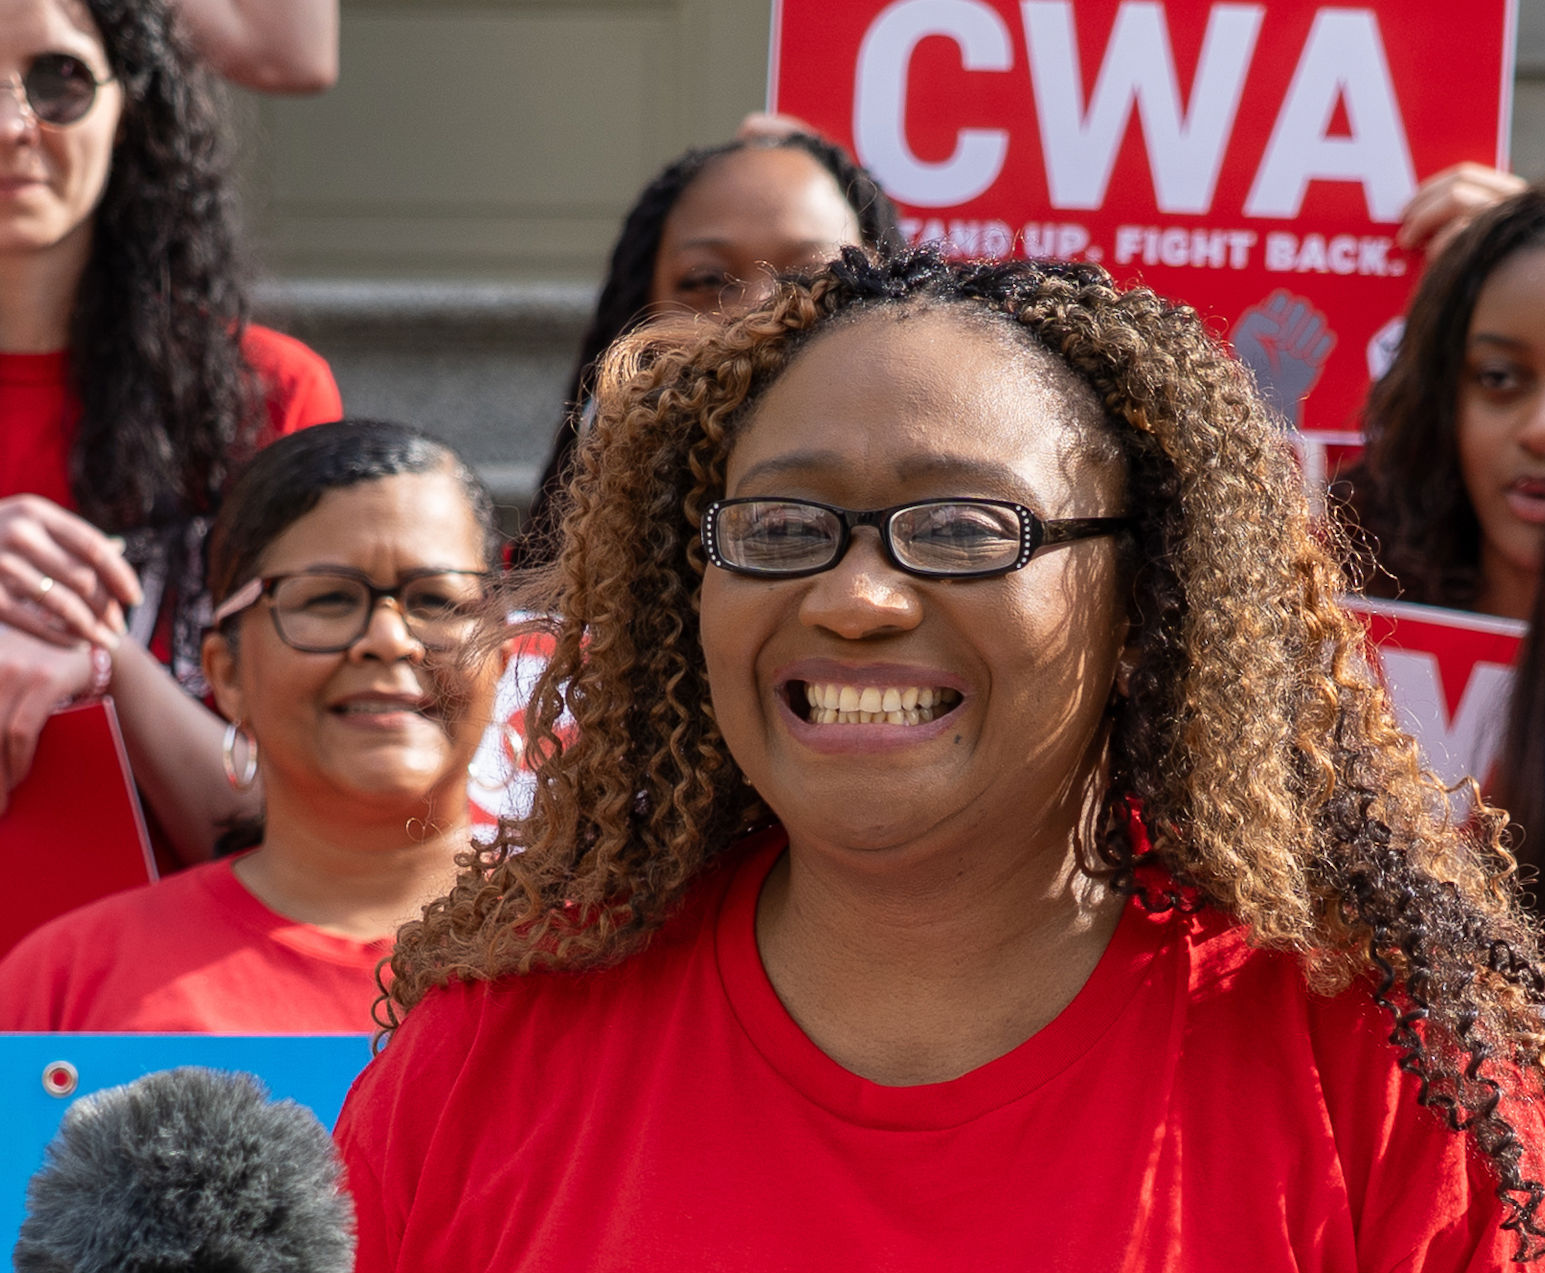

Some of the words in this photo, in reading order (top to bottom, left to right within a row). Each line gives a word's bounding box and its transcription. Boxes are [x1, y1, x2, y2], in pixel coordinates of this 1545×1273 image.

[855, 0, 1418, 223] CWA
[898, 219, 1013, 262] TAND
[1024, 222, 1103, 264] UP.
[1114, 225, 1257, 271] FIGHT
[1265, 233, 1406, 277] BACK.
